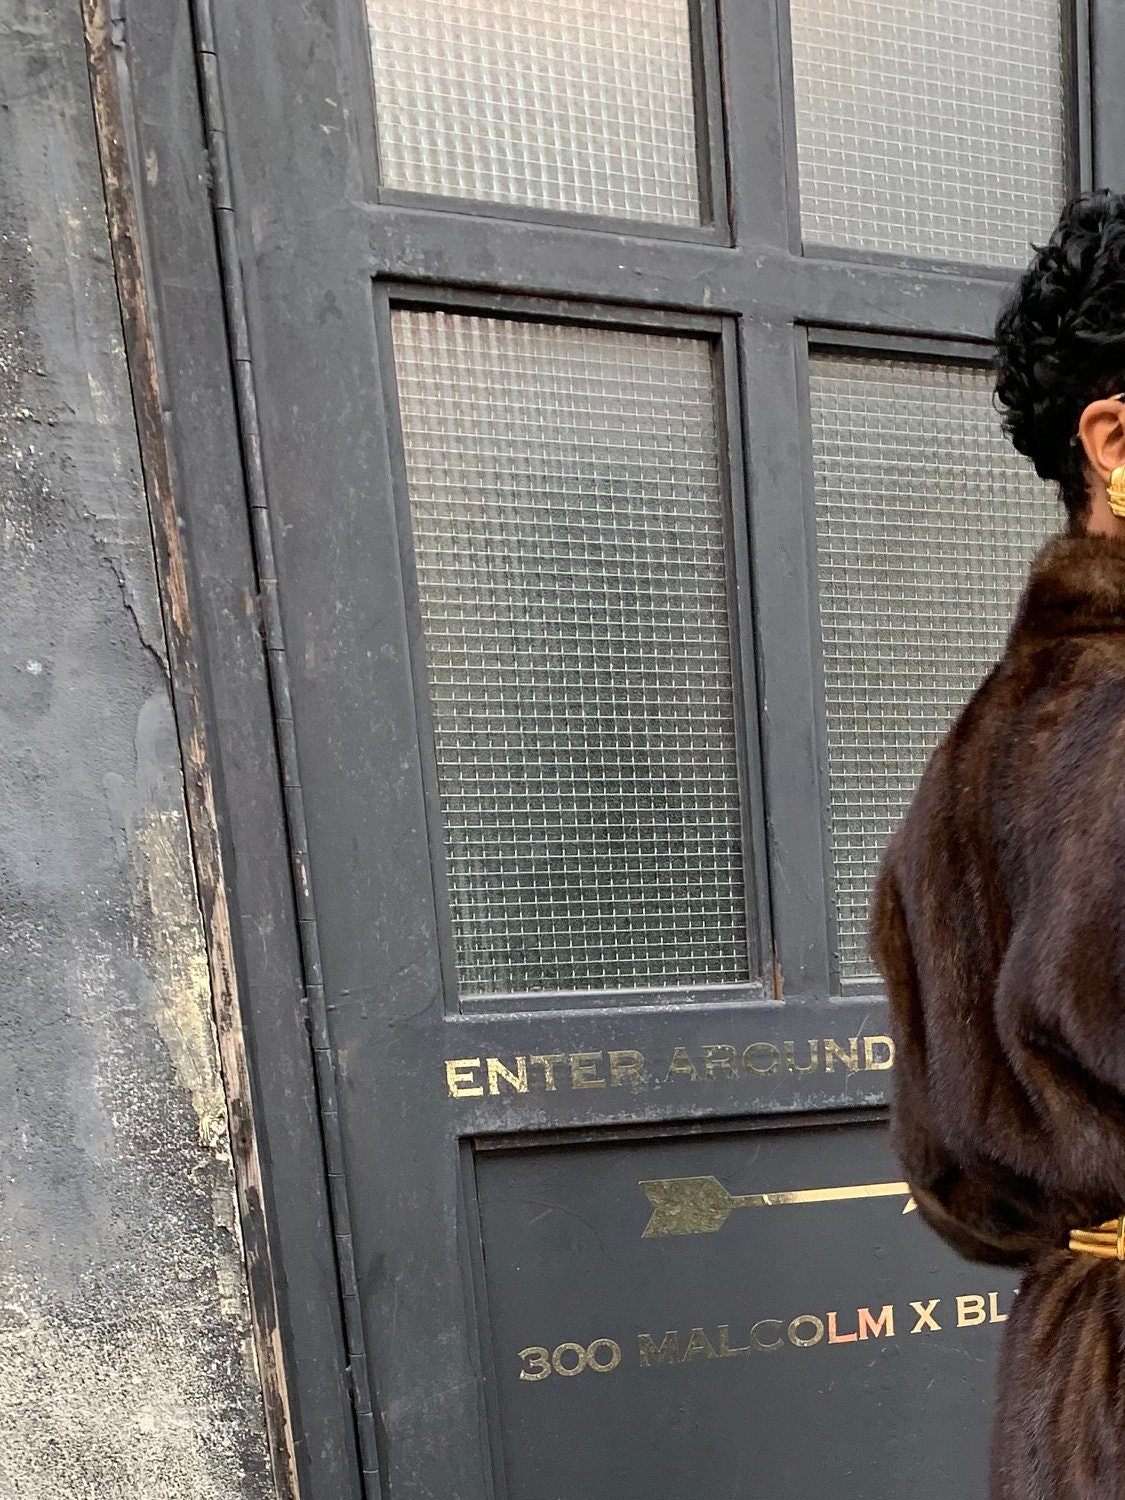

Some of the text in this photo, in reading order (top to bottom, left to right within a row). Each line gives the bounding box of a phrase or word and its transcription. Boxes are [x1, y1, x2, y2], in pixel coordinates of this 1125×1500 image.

[444, 1035, 896, 1098] ENTER AROUND
[517, 1289, 1019, 1381] 300 MALCOLM X BL
